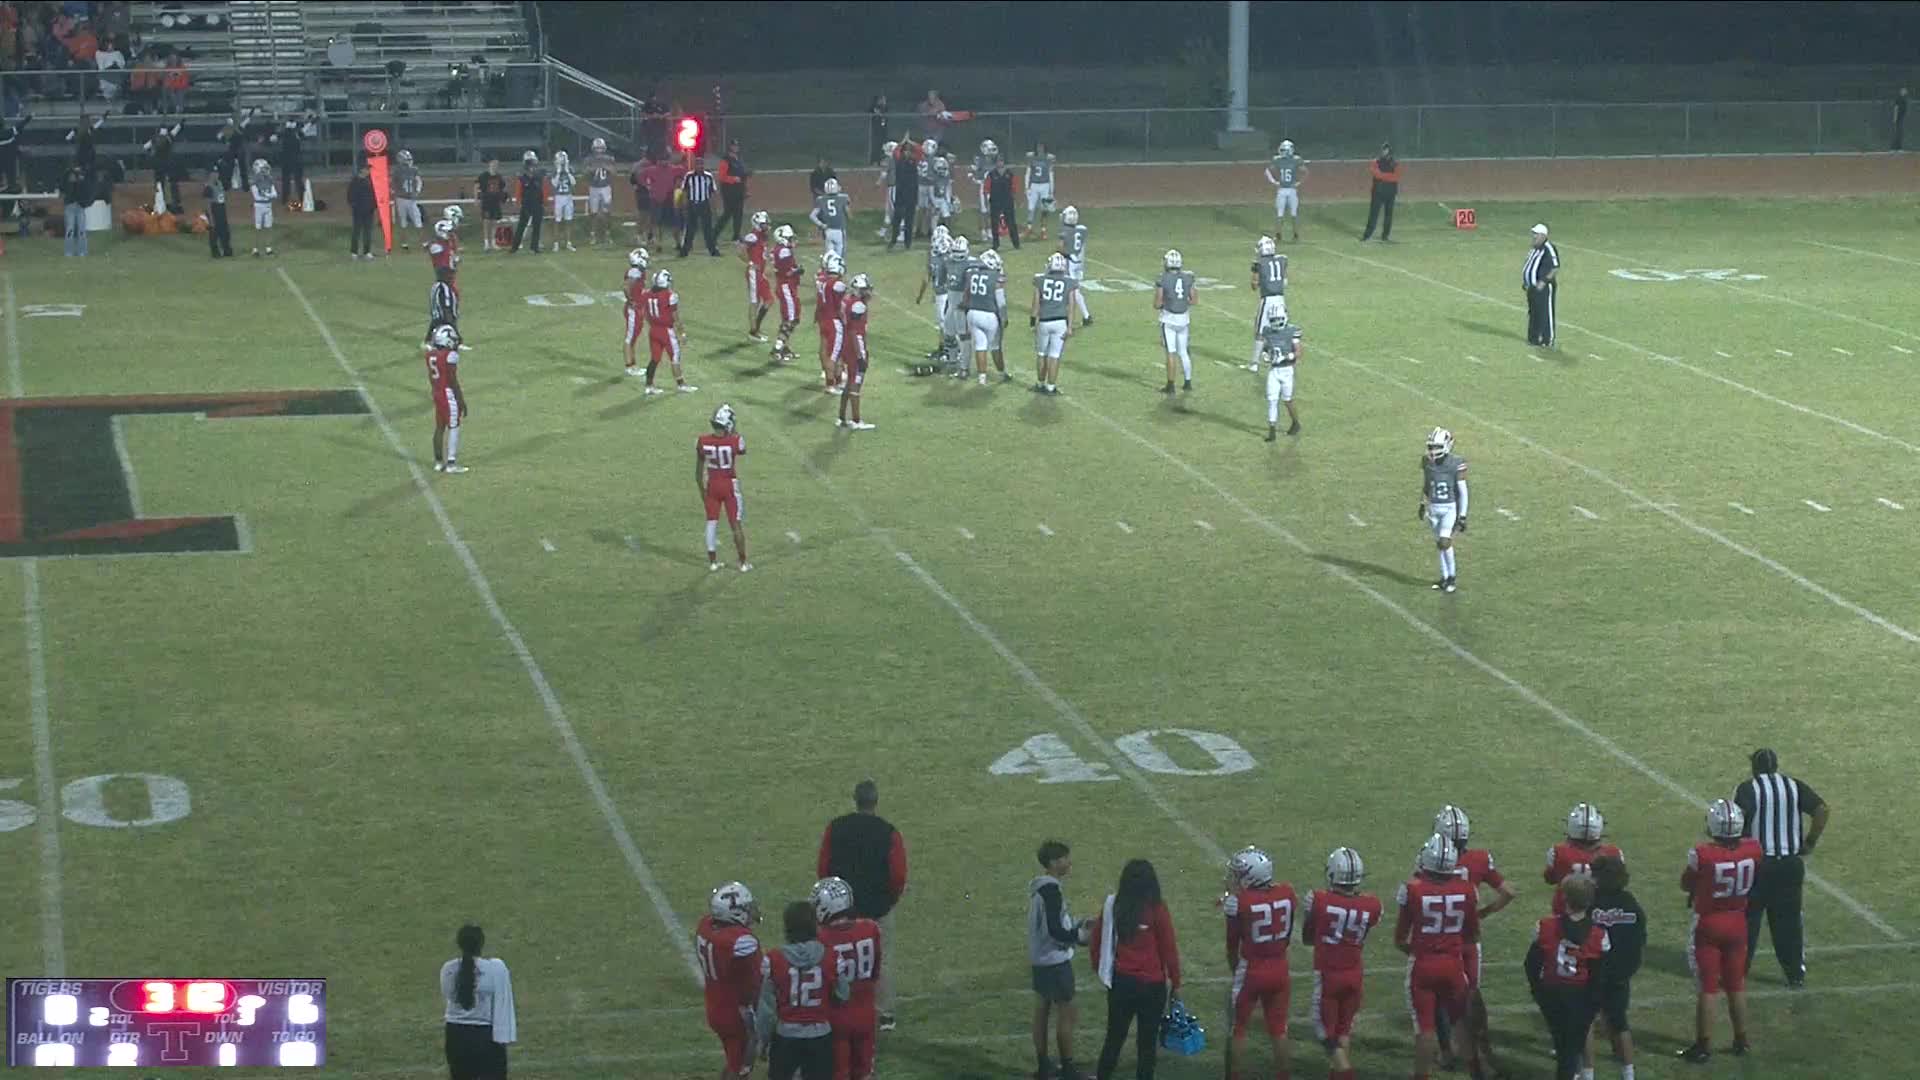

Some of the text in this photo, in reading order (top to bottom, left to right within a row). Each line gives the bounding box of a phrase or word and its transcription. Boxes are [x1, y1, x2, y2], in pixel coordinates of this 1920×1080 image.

[826, 199, 838, 217] 5
[1459, 211, 1477, 225] 20
[1270, 261, 1282, 282] 11
[969, 274, 988, 296] 65
[1042, 279, 1065, 301] 52
[1174, 278, 1184, 299] 4
[647, 297, 660, 318] 11
[428, 357, 440, 379] 5
[703, 445, 732, 469] 20
[989, 729, 1258, 784] 40
[1713, 859, 1755, 901] 50
[1249, 899, 1293, 946] 23
[1322, 905, 1371, 947] 34
[1421, 894, 1467, 936] 55
[788, 966, 823, 1008] 12
